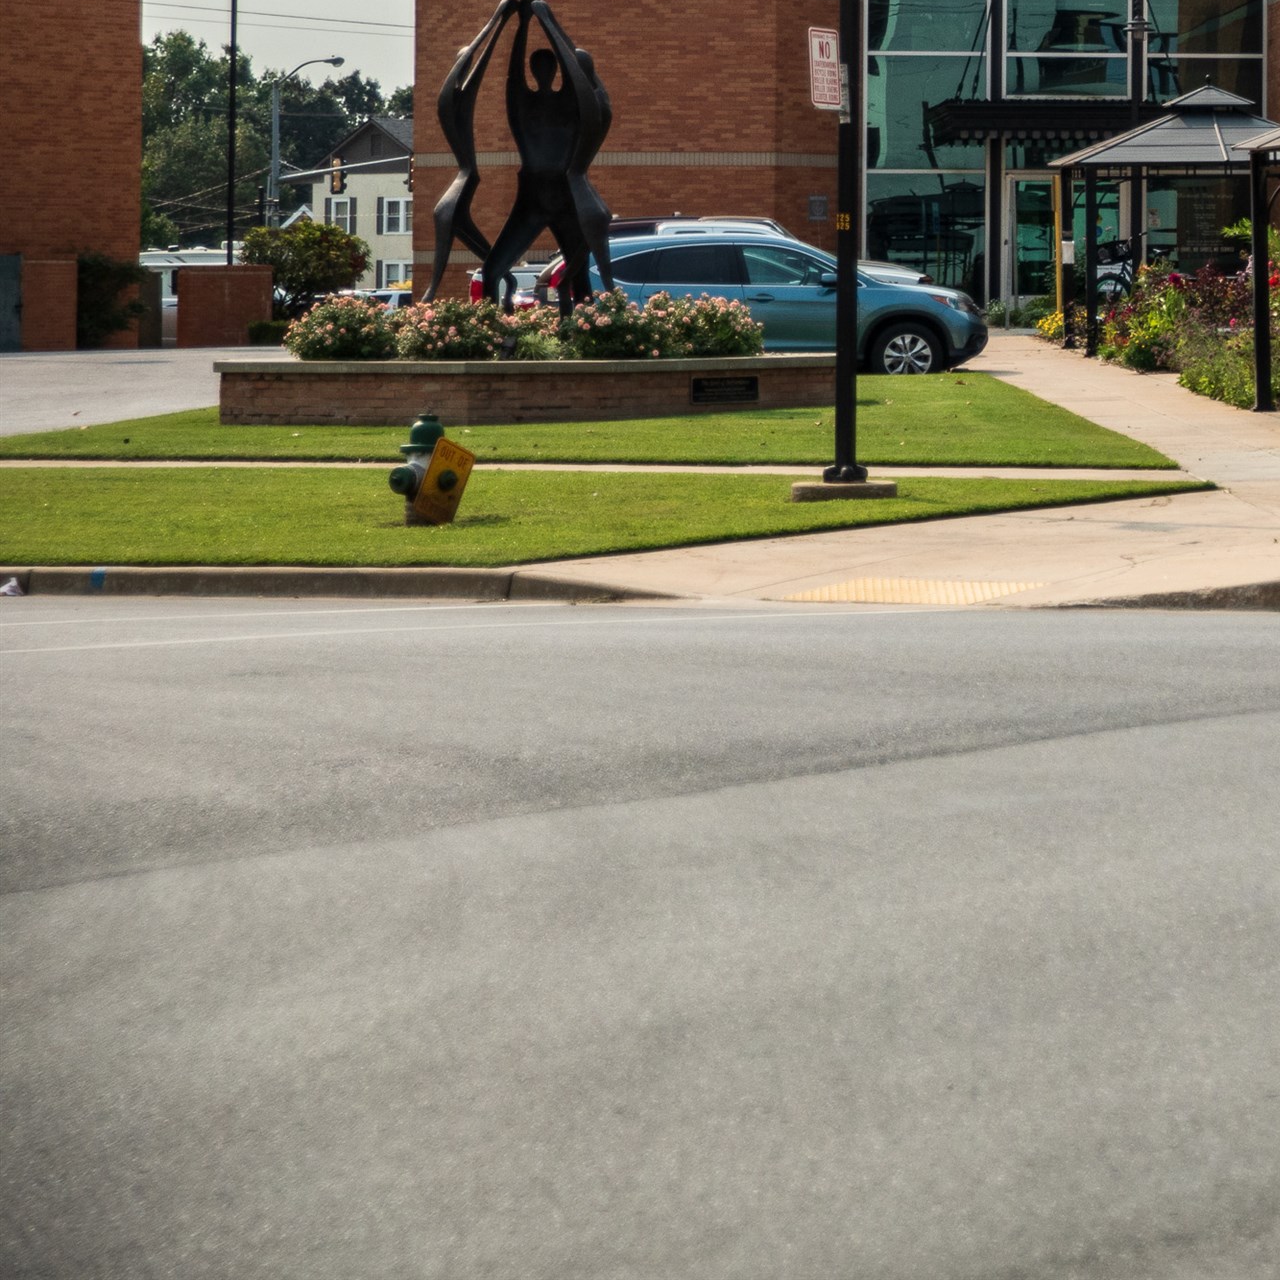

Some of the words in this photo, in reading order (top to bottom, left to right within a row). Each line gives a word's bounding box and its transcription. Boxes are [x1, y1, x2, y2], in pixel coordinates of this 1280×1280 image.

[819, 41, 830, 59] NO
[440, 446, 456, 463] OUT
[457, 455, 470, 469] OF
